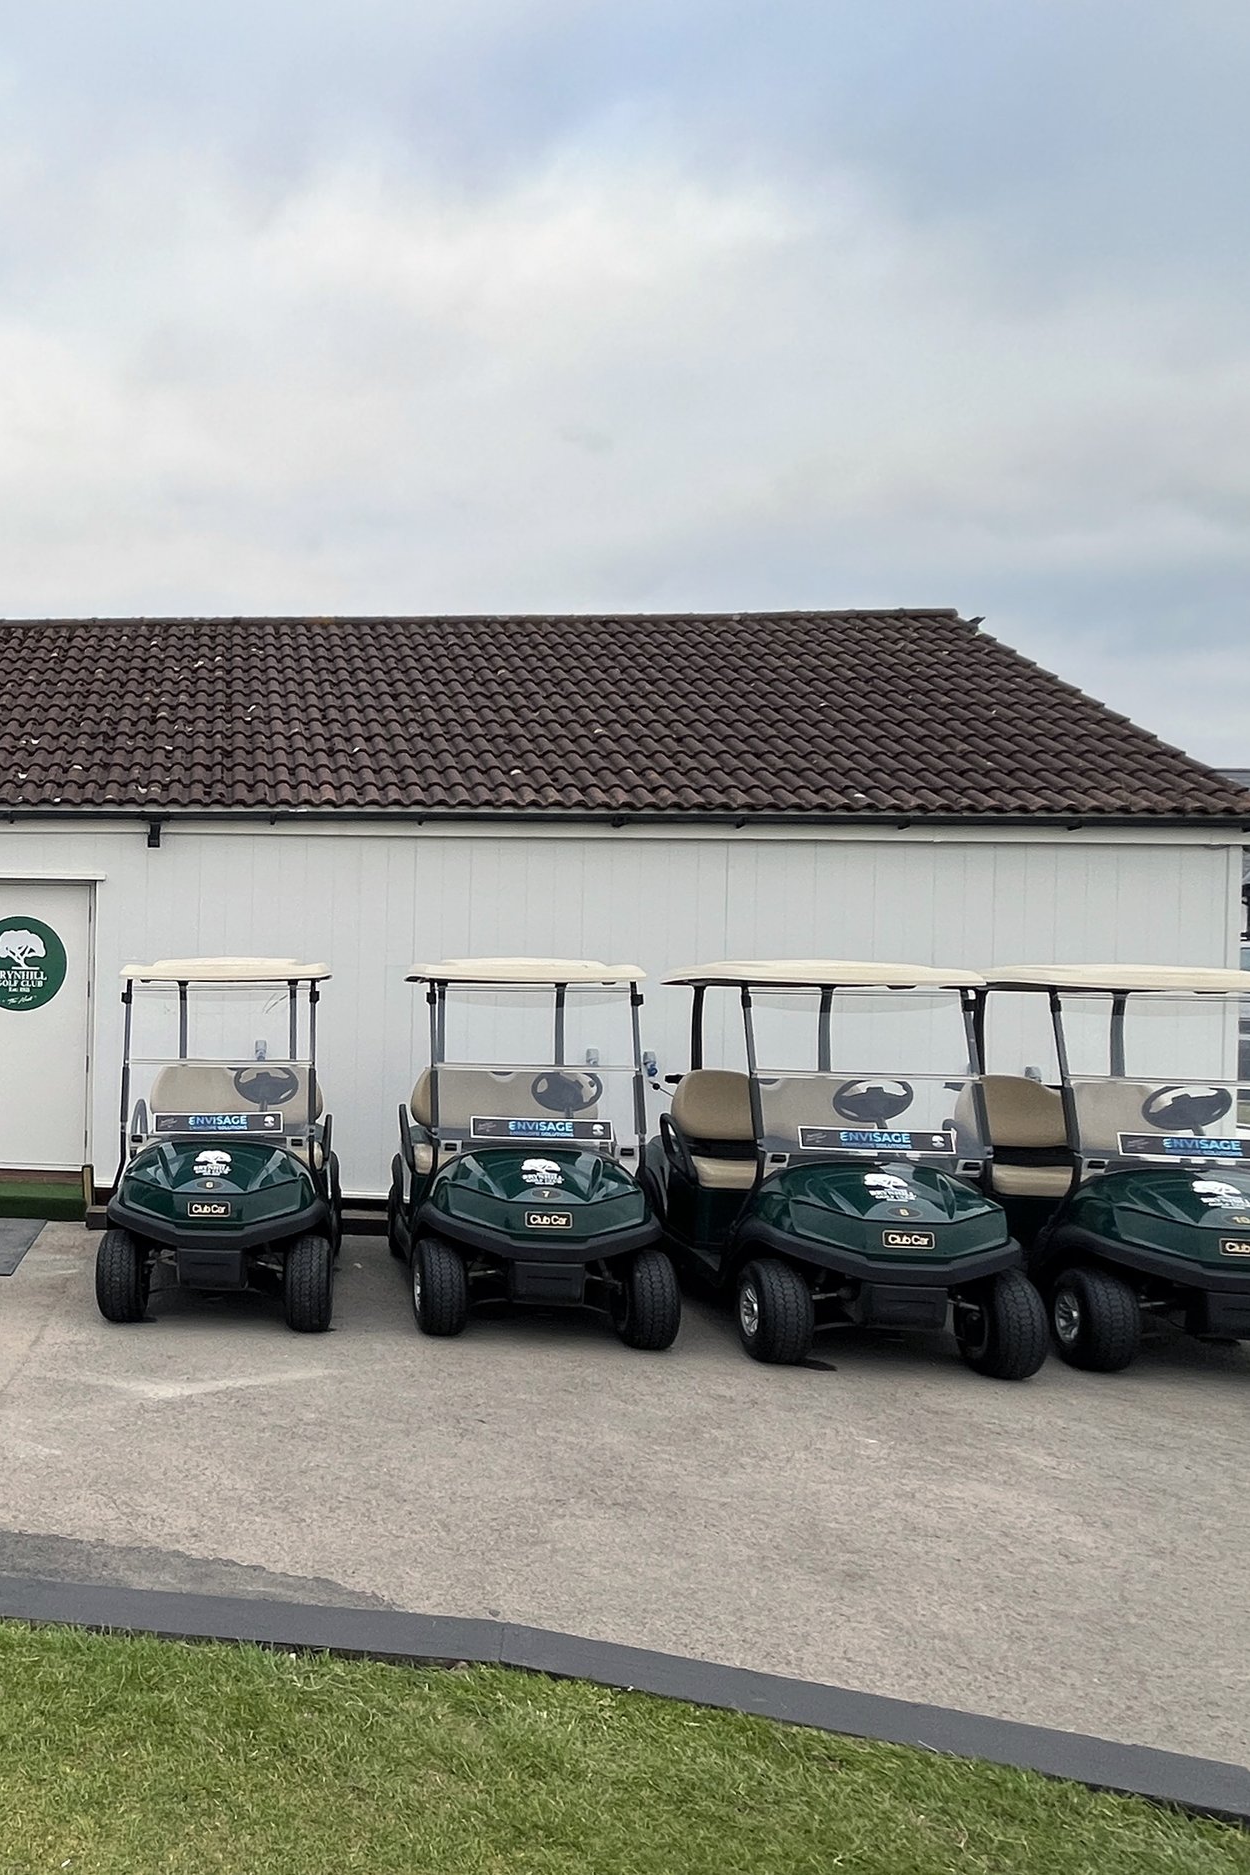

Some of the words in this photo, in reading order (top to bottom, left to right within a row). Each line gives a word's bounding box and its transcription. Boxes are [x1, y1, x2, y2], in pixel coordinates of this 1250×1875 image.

[20, 980, 43, 988] CLUB
[188, 1115, 247, 1125] ENVISAGE
[508, 1121, 574, 1132] ENVISAGE
[839, 1131, 911, 1143] ENVISAGE
[1163, 1138, 1242, 1151] ENVISAGE
[542, 1190, 550, 1198] 7
[192, 1203, 210, 1213] Club
[211, 1204, 226, 1213] Car
[530, 1214, 550, 1224] Club
[551, 1215, 567, 1225] Car
[888, 1234, 911, 1244] Club
[912, 1235, 930, 1245] Car
